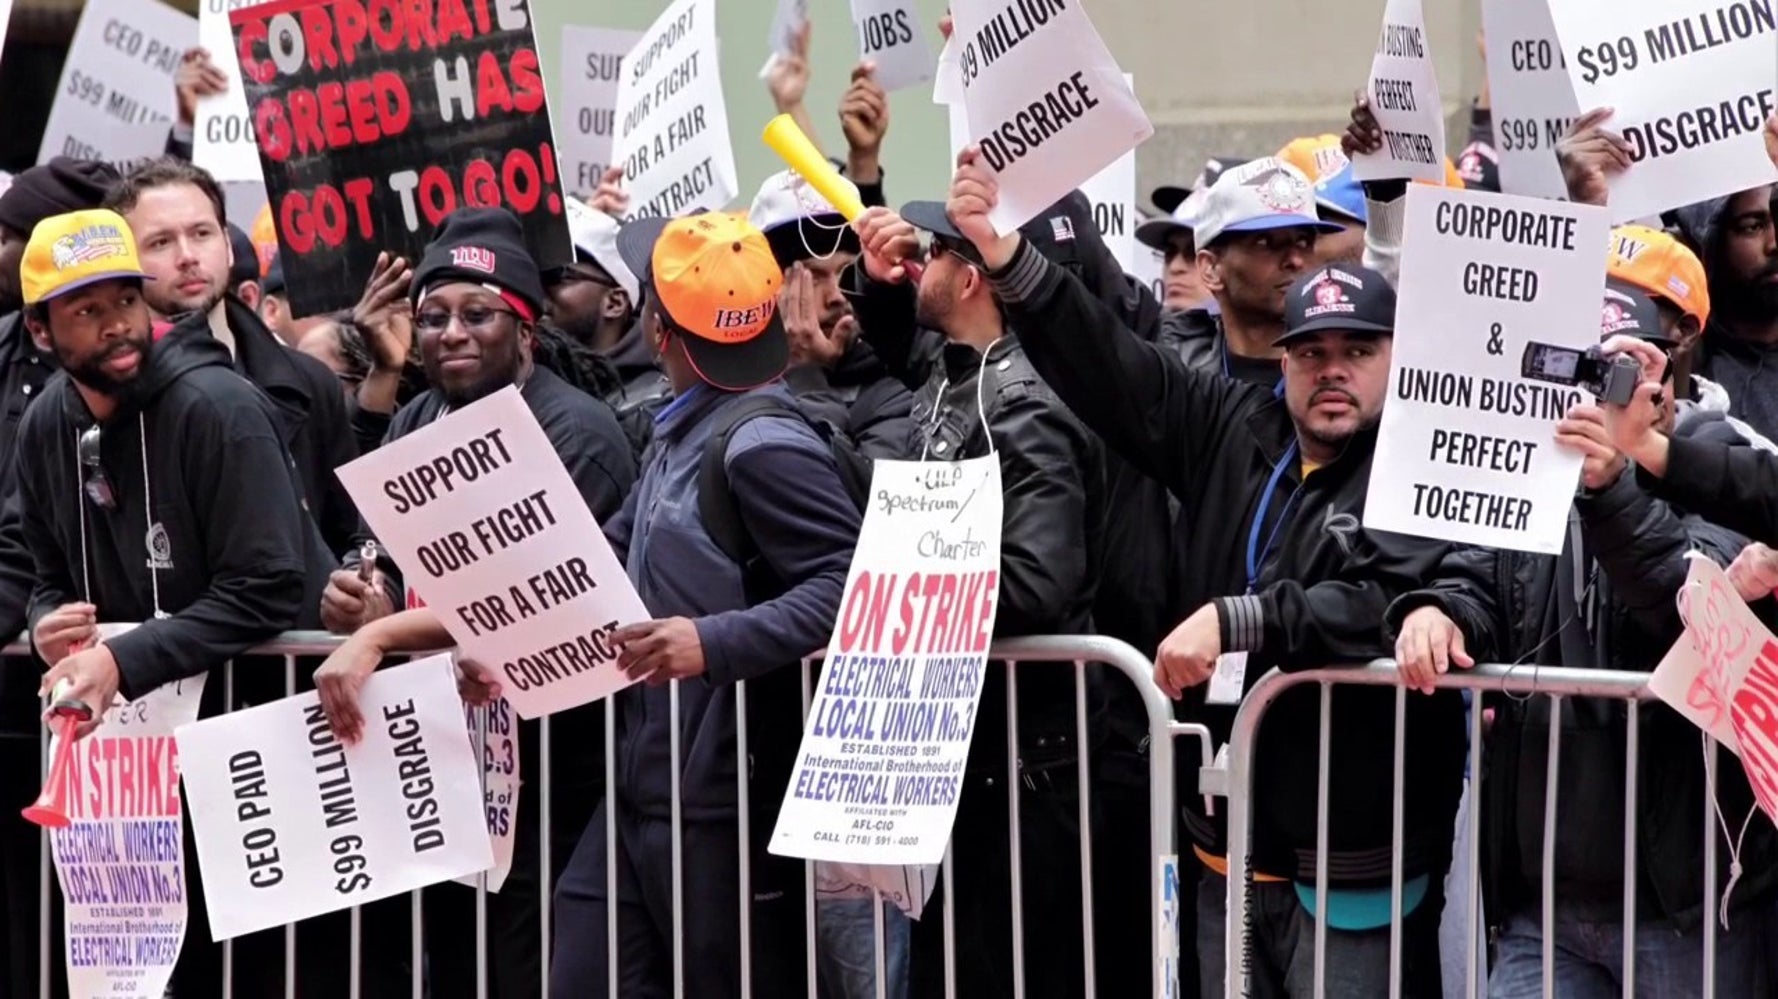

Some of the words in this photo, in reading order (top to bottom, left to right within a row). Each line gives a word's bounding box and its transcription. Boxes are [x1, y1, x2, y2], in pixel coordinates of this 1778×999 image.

[103, 18, 142, 57] CEO
[143, 38, 182, 74] PAI
[631, 3, 696, 87] SUPPORT
[863, 8, 912, 54] JOBS
[1387, 24, 1423, 59] BUSTING
[1577, 36, 1638, 84] $99
[1644, 0, 1776, 64] MILLION
[1511, 39, 1551, 71] CEO
[67, 70, 104, 106] $99
[255, 70, 412, 161] GREED
[433, 48, 544, 122] HAS
[623, 92, 650, 138] OUR
[655, 51, 700, 108] FIGHT
[1375, 77, 1417, 111] PERFECT
[654, 134, 664, 164] A
[668, 104, 707, 152] FAIR
[980, 70, 1099, 173] DISGRACE
[1500, 118, 1538, 151] $99
[1622, 89, 1774, 163] DISGRACE
[1384, 131, 1437, 165] TOGETHER
[280, 177, 374, 254] GOT
[1436, 201, 1577, 251] CORPORATE
[1463, 262, 1538, 302] GREED
[714, 296, 776, 328] IBEW
[1486, 322, 1503, 356] &
[1398, 366, 1473, 408] UNION
[384, 428, 513, 515] SUPPORT
[1430, 429, 1537, 475] PERFECT
[1413, 483, 1532, 532] TOGETHER
[416, 531, 479, 578] OUR
[472, 490, 557, 555] FIGHT
[456, 595, 516, 636] FOR
[509, 585, 537, 619] A
[527, 556, 598, 612] FAIR
[840, 570, 897, 653] ON
[892, 570, 997, 656] STRIKE
[503, 620, 627, 692] CONTRACT
[824, 655, 916, 699] ELECTRICAL
[919, 656, 982, 700] WORKERS
[813, 698, 877, 740] LOCAL
[880, 701, 939, 742] UNION
[936, 701, 974, 742] No.3
[303, 703, 359, 829] MILLION
[803, 753, 884, 772] International
[885, 759, 951, 773] Brotherhood
[952, 759, 963, 772] of
[840, 743, 917, 756] ESTABLISHED
[921, 746, 941, 756] 1891
[88, 736, 180, 819] STRIKE
[228, 749, 272, 822] PAID
[382, 698, 445, 853] DISGRACE
[794, 770, 890, 805] ELECTRICAL
[892, 774, 958, 807] WORKERS
[56, 822, 119, 864] ELECTRICAL
[122, 820, 179, 862] WORKERS
[813, 831, 840, 842] CALL
[845, 833, 871, 845] (718)
[852, 819, 894, 831] AFL-CIO
[242, 828, 283, 889] CEO
[330, 834, 373, 895] $99
[63, 866, 108, 904] LOCAL
[108, 865, 150, 904] UNION
[70, 921, 124, 935] International
[125, 920, 173, 934] Brotherhood
[90, 907, 144, 918] ESTABLISHED
[70, 936, 132, 967] ELECTRICAL
[134, 936, 179, 967] WORKERS
